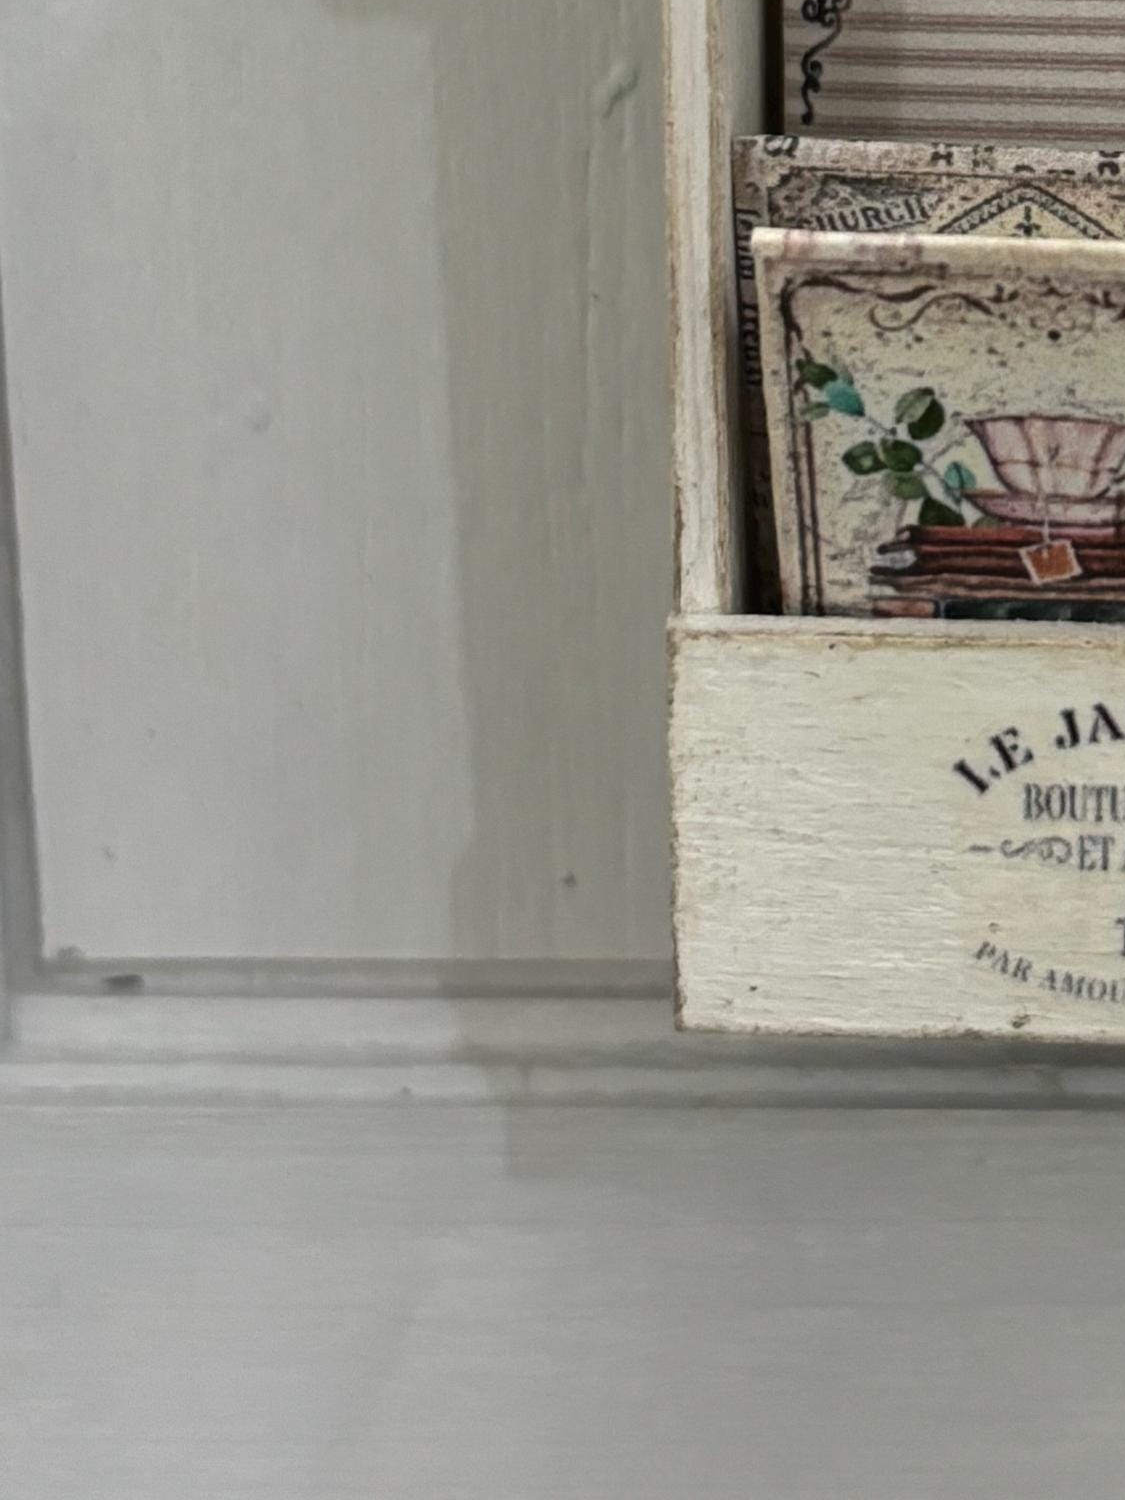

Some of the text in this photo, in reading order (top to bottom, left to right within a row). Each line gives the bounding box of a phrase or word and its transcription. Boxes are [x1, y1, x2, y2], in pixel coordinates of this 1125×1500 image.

[952, 726, 1035, 796] LE
[1077, 834, 1115, 872] ET
[973, 941, 1031, 983] PAR
